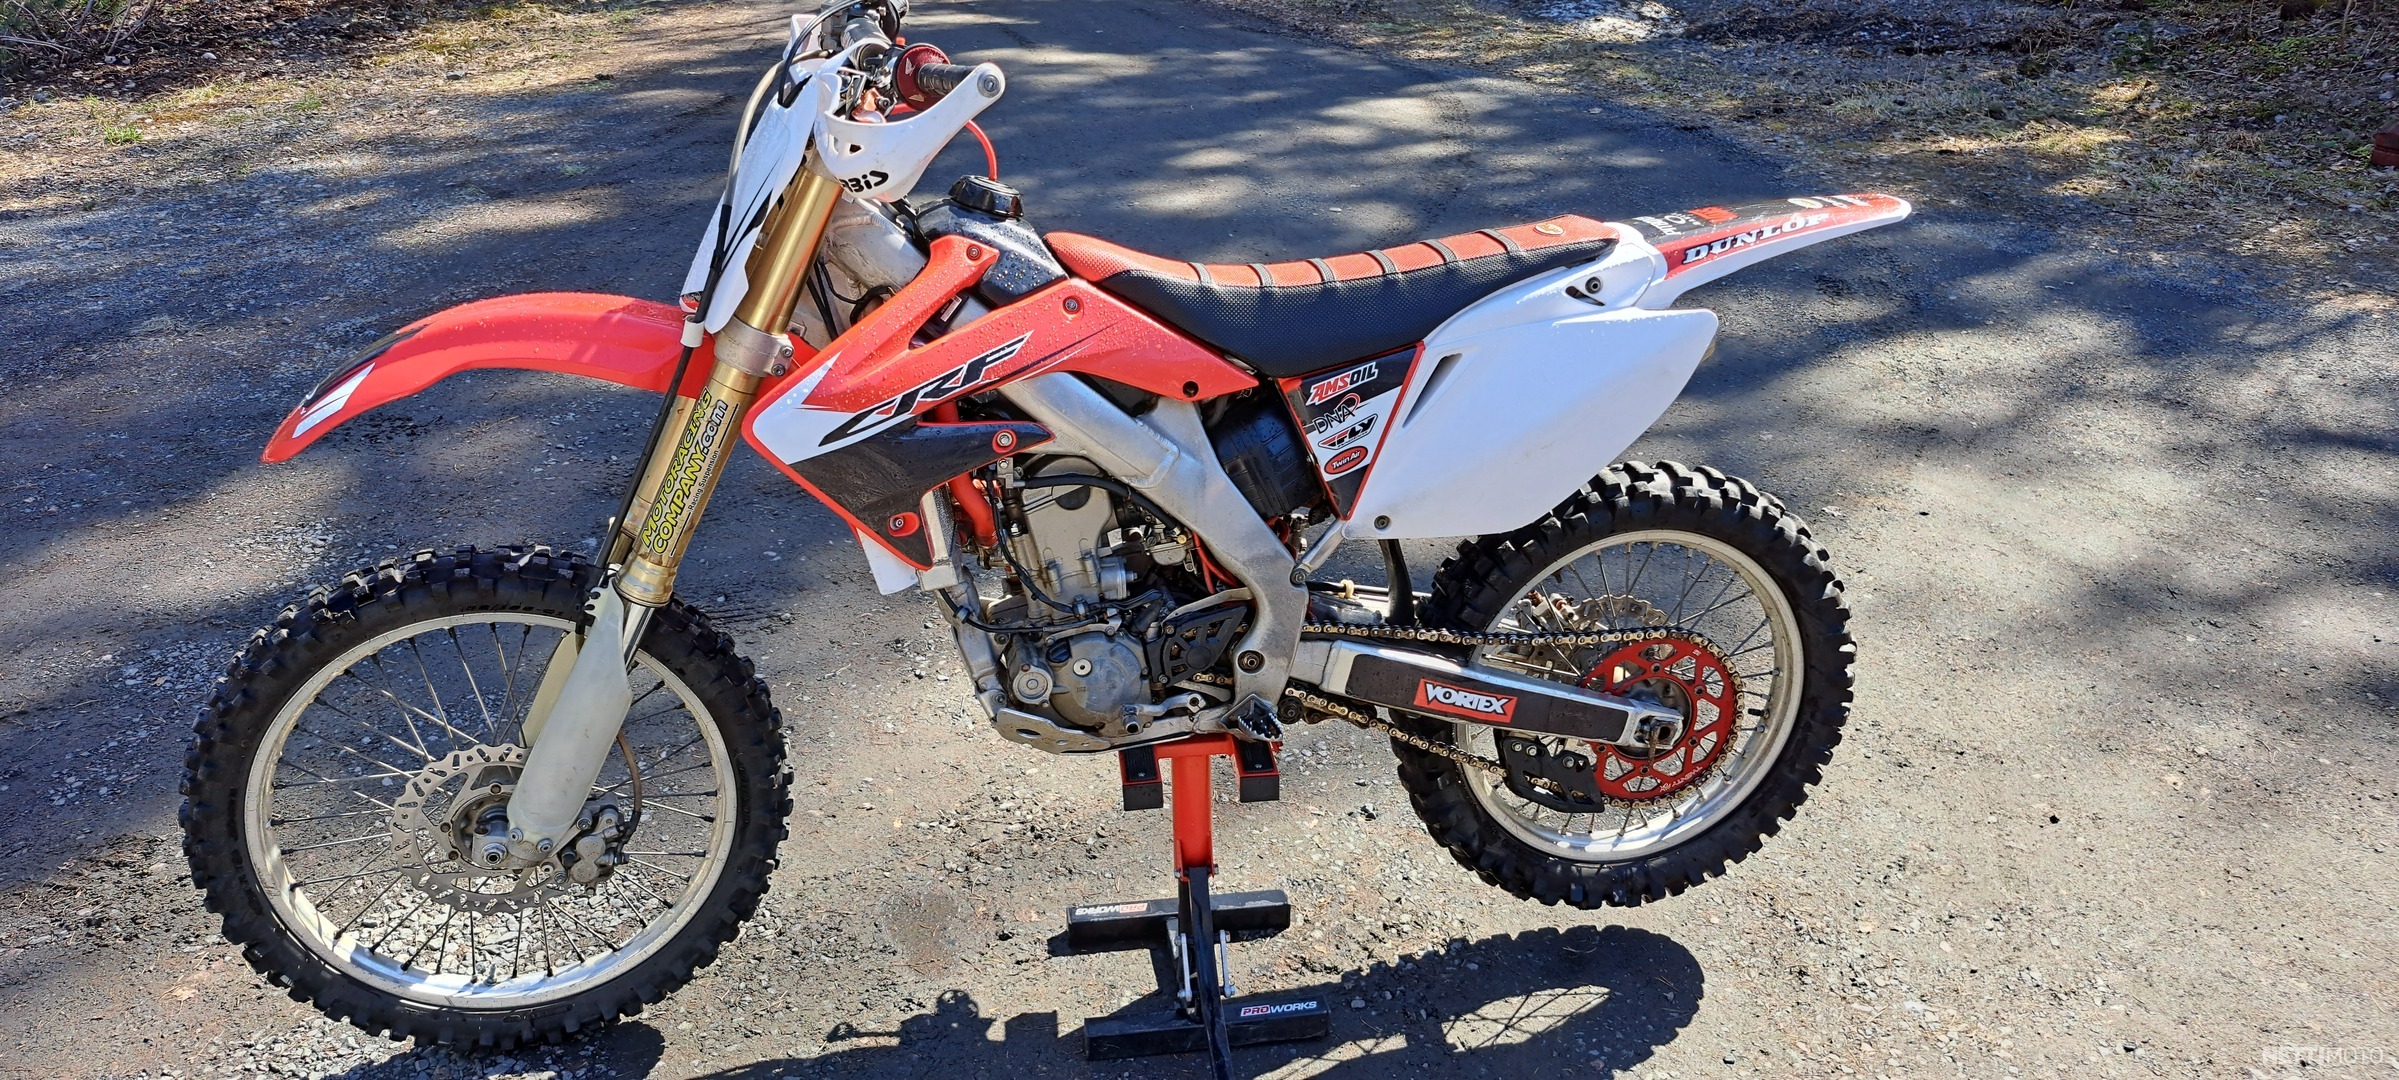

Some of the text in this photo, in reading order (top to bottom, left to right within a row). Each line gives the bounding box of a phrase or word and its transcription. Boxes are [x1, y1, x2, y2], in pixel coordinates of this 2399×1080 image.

[1682, 213, 1830, 265] DUNLOP
[818, 331, 1034, 447] CRF
[1306, 362, 1378, 405] AMSOIL
[1313, 404, 1355, 434] DNA
[1320, 415, 1375, 447] FLY
[641, 386, 713, 549] MOTORACING
[653, 399, 729, 554] COMPANY.com
[688, 449, 720, 511] Racing Suspension
[1332, 450, 1361, 469] Twin Air
[1424, 682, 1510, 716] VORTEX
[1240, 1001, 1318, 1017] PROWORKS
